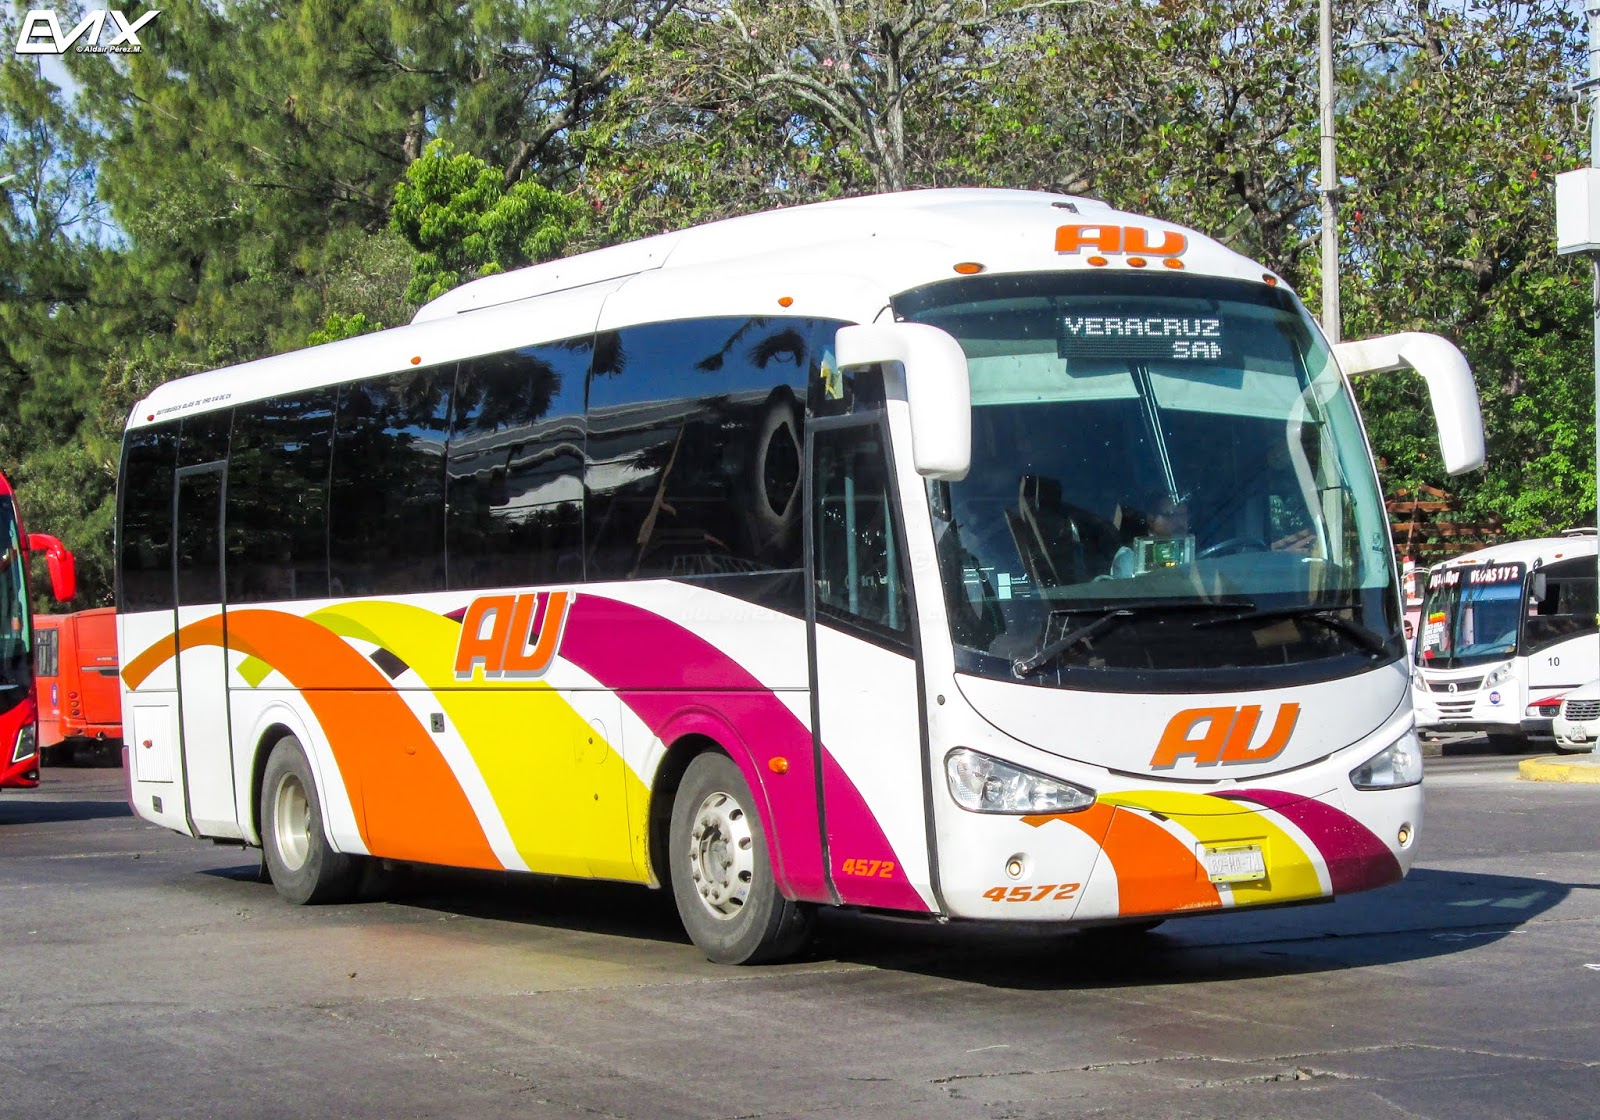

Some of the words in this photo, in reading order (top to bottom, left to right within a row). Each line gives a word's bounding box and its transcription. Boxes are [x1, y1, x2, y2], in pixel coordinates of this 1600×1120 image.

[1055, 224, 1188, 258] AU
[1065, 317, 1220, 336] VERACRUZ
[453, 591, 571, 680] AU
[1548, 657, 1560, 667] 10
[1149, 702, 1301, 771] AU
[842, 858, 895, 878] 4572
[983, 883, 1080, 902] 4572
